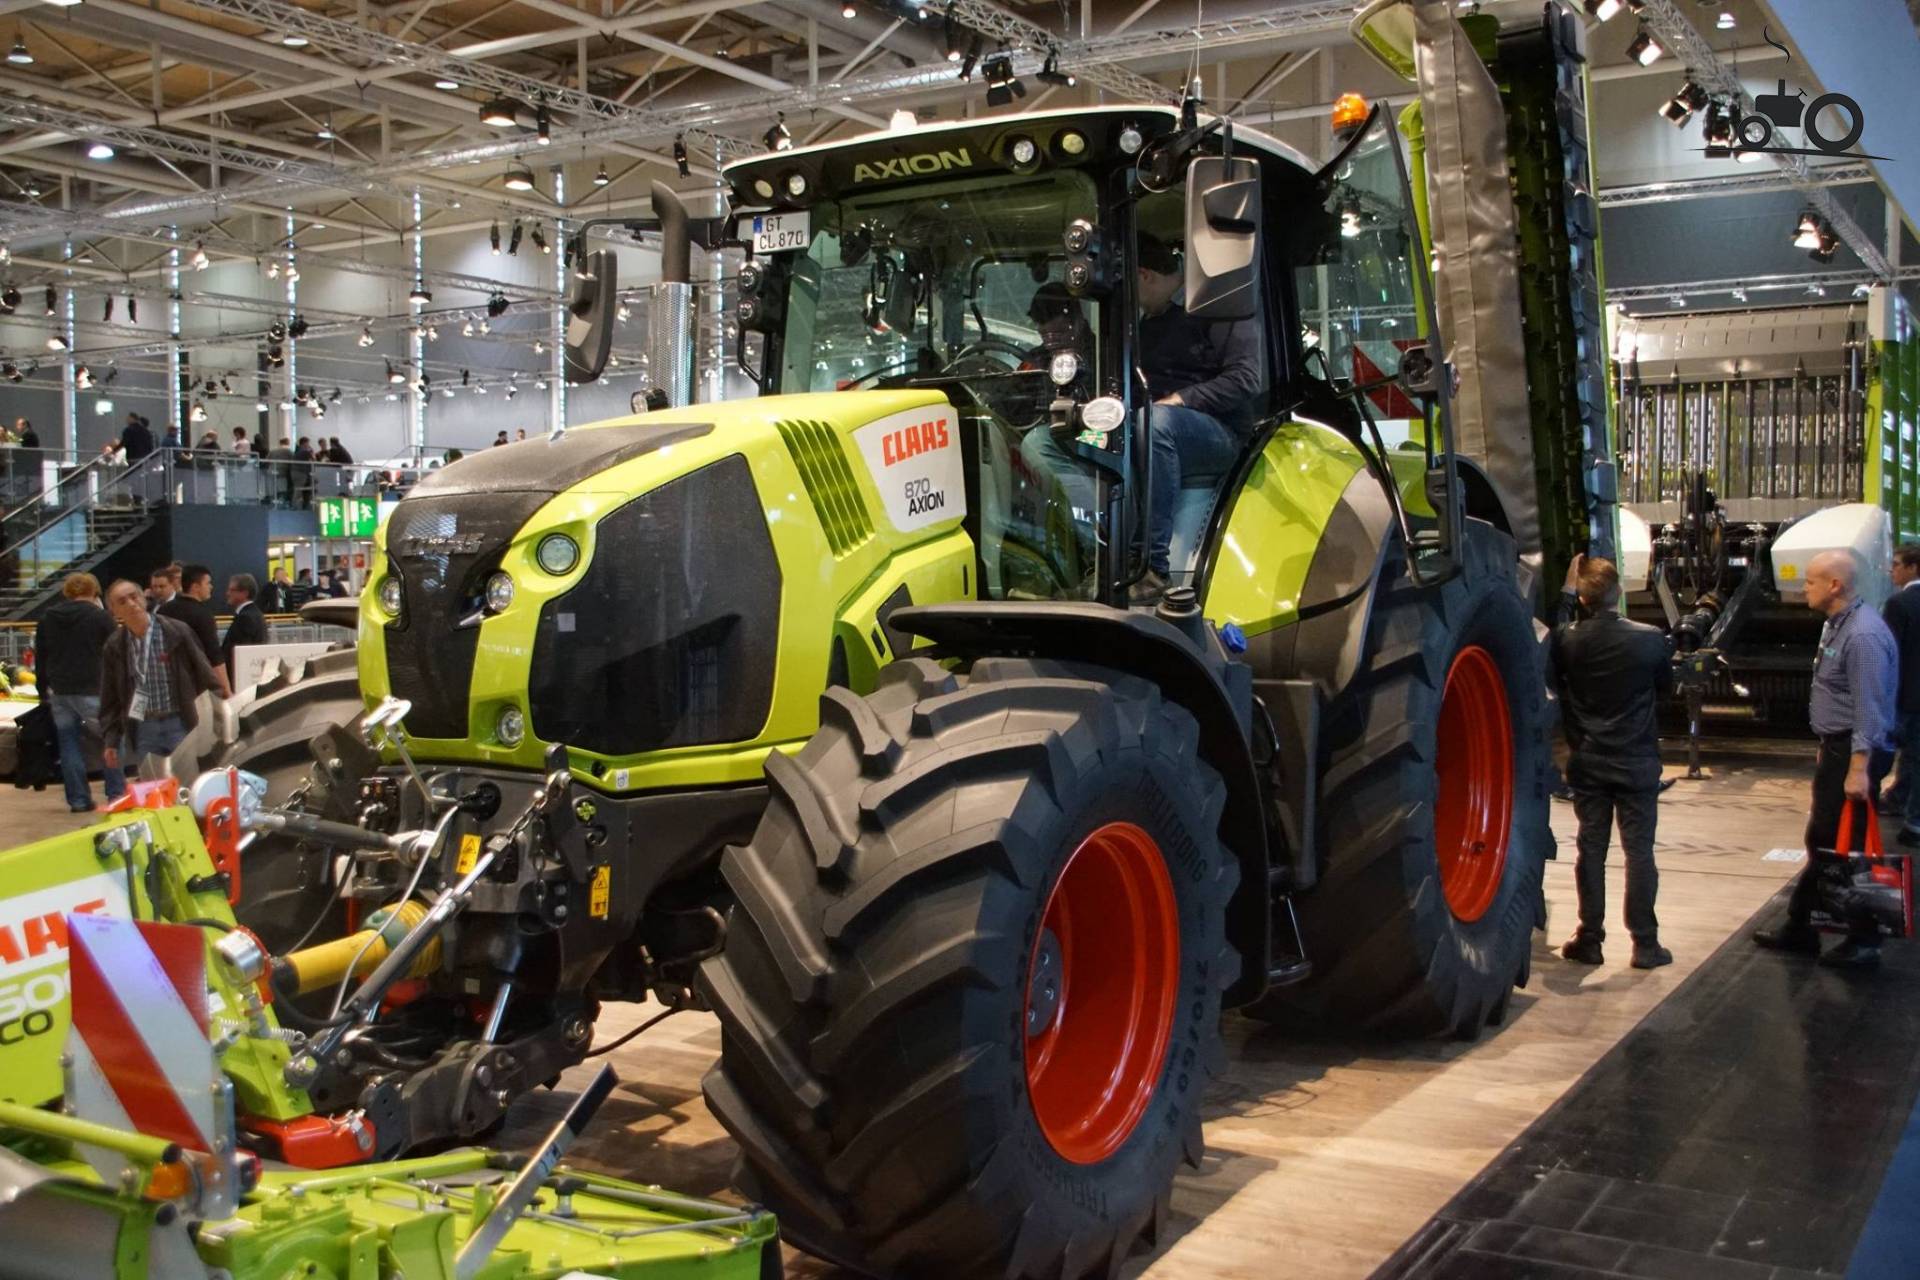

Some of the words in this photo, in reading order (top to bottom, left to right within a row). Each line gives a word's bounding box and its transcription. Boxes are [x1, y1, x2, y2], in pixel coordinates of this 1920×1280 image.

[854, 148, 972, 183] AXION
[766, 216, 782, 232] GT
[882, 418, 949, 467] CLAAS
[904, 478, 931, 499] 870
[908, 491, 945, 516] AXION
